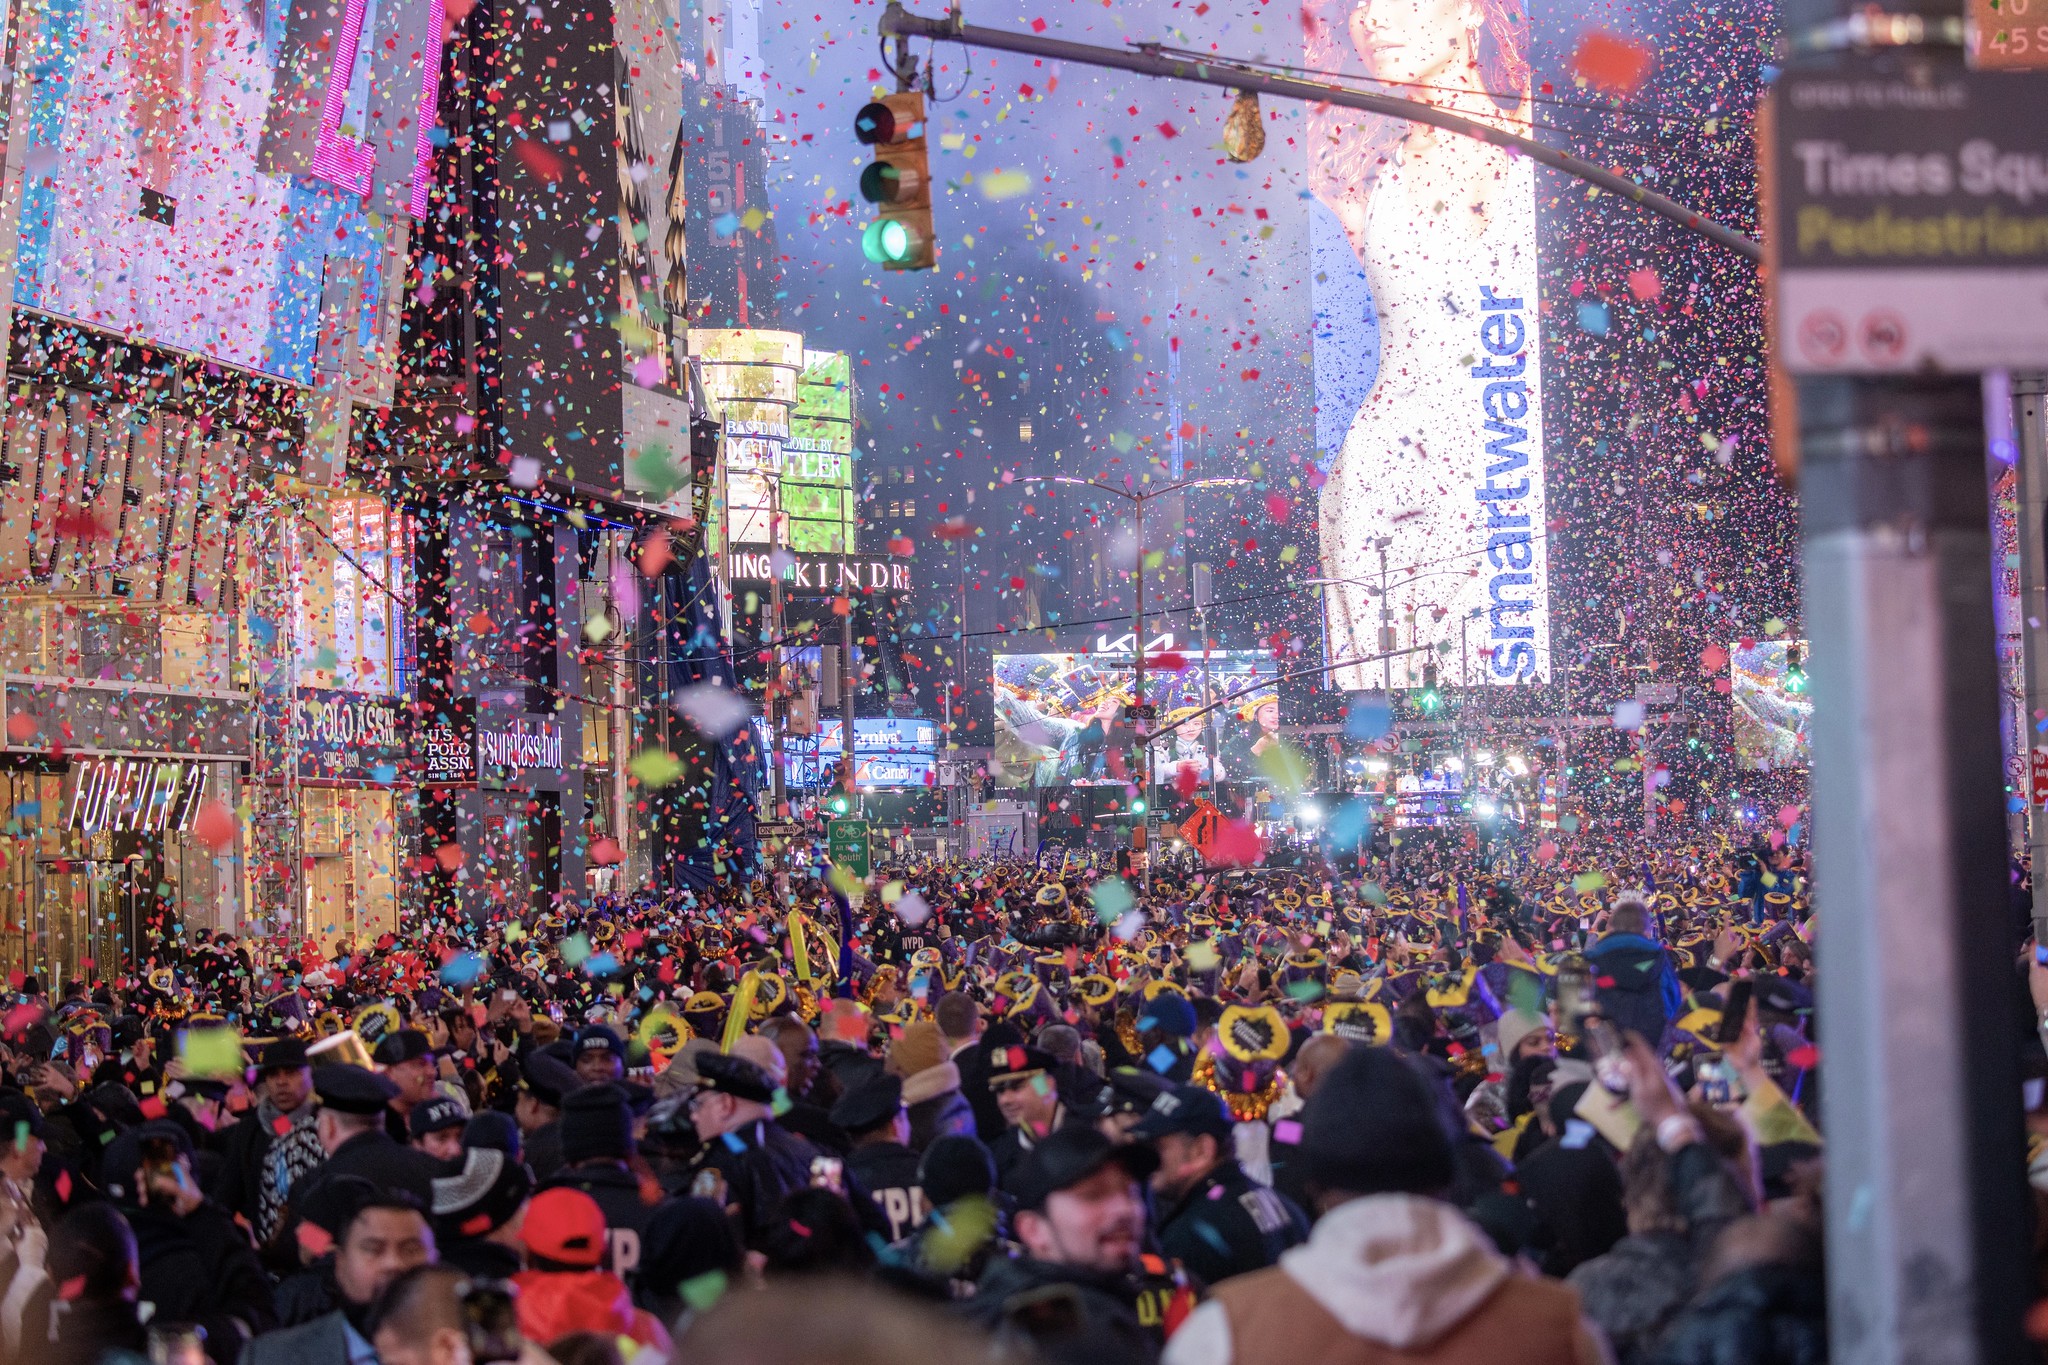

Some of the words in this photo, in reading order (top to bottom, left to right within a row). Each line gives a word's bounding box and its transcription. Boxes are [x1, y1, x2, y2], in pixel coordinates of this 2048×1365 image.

[1793, 139, 1952, 197] Times
[820, 439, 833, 452] BY
[1471, 284, 1536, 679] smartwater
[427, 742, 471, 757] POLO
[486, 718, 540, 781] sunglass
[542, 720, 564, 769] hut
[427, 756, 474, 771] ASSN.
[2033, 753, 2045, 765] NO
[67, 760, 180, 832] FOREVER
[177, 764, 209, 832] 21
[783, 825, 799, 834] WAY
[838, 852, 861, 862] South
[901, 936, 924, 950] NYPD
